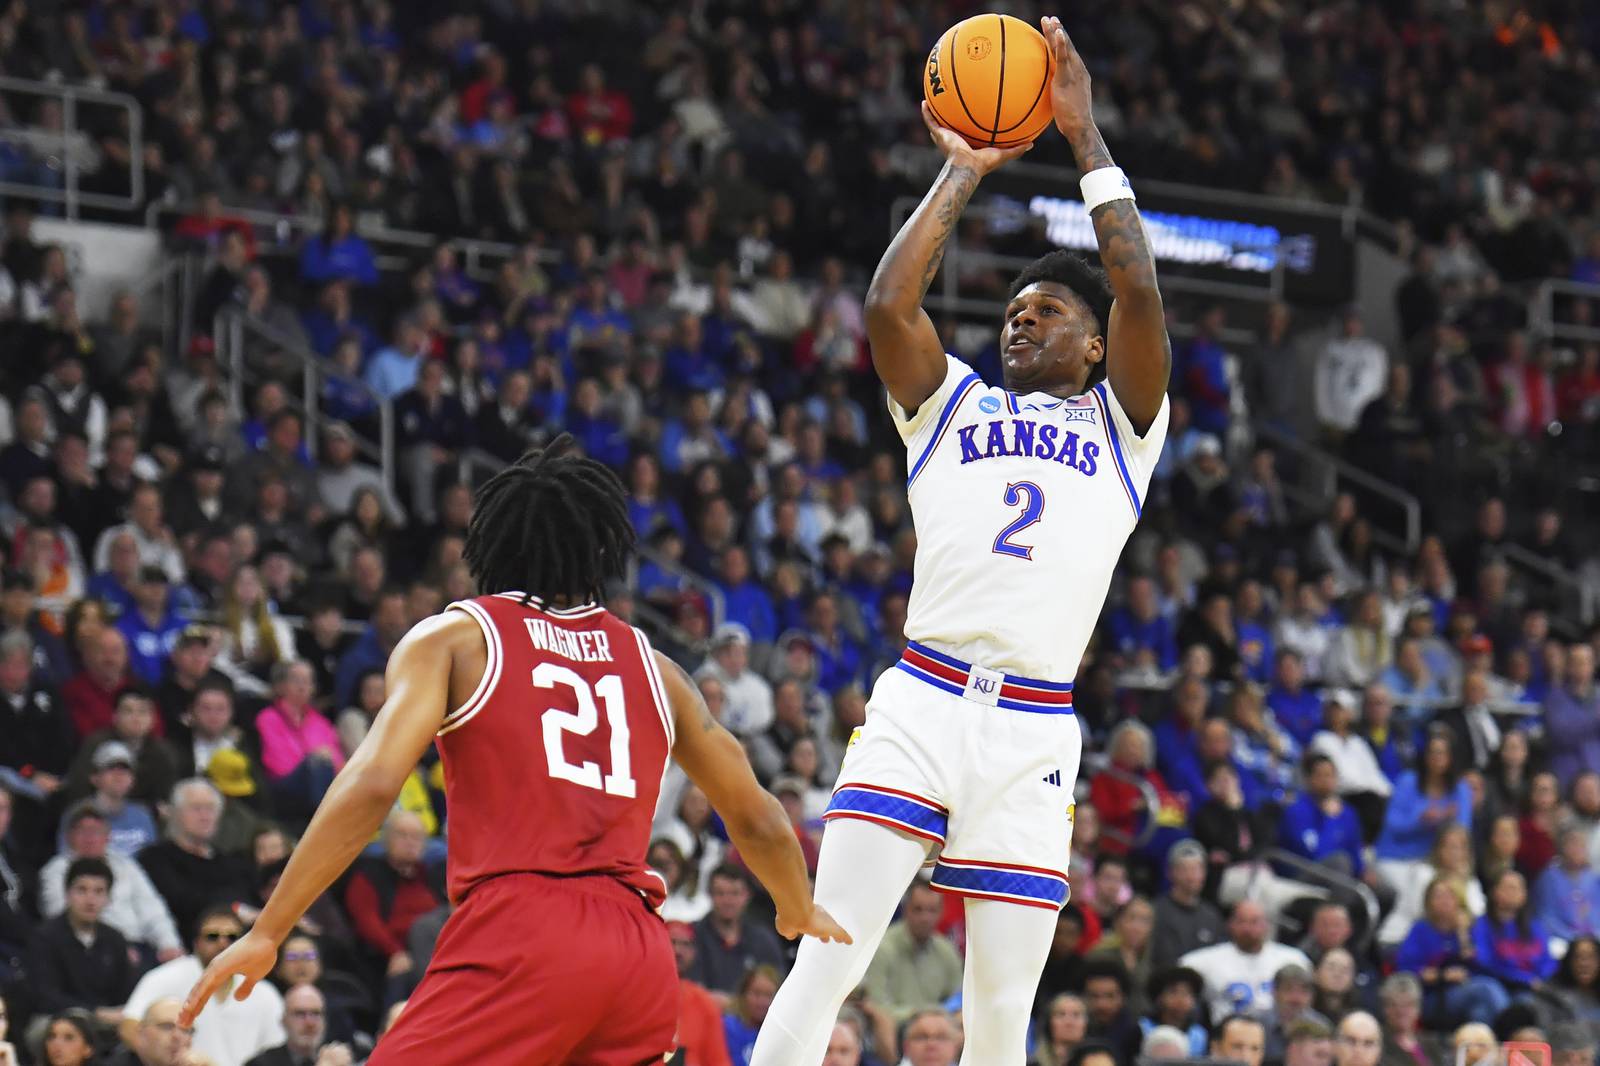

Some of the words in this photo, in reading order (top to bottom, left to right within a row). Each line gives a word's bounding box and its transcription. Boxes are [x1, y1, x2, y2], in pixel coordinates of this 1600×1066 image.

[957, 419, 1100, 477] KANSAS
[992, 480, 1045, 561] 2
[523, 618, 614, 662] WAGNER
[973, 676, 996, 694] KU
[531, 662, 637, 799] 21
